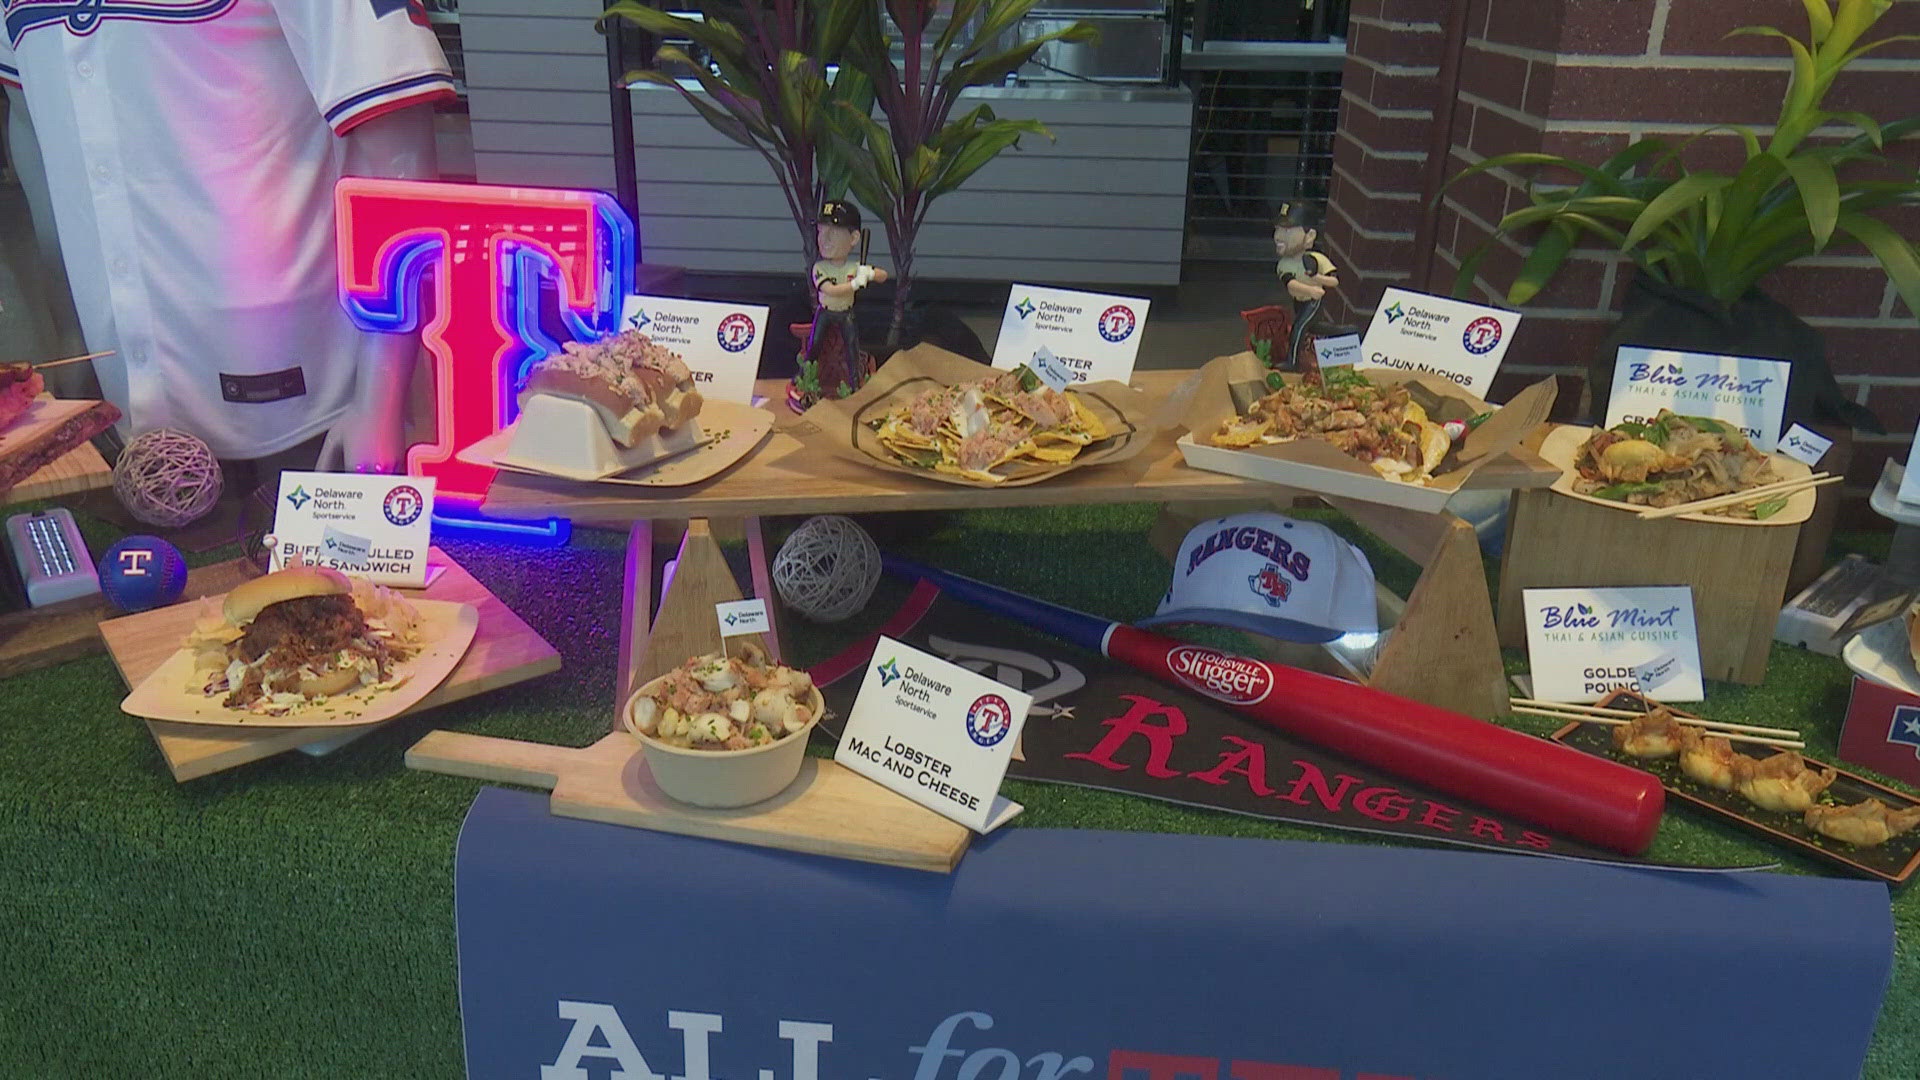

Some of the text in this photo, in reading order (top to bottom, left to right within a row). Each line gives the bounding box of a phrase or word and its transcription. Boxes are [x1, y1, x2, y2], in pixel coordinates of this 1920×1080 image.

[1040, 301, 1083, 314] Delaware
[1408, 306, 1450, 323] Delaware
[654, 312, 699, 324] Delaware
[1036, 312, 1064, 322] North
[1404, 317, 1430, 331] North
[652, 323, 681, 334] North
[1035, 322, 1073, 333] Sportservice
[1400, 328, 1437, 341] Sportservice
[334, 175, 636, 553] T
[1371, 352, 1414, 371] CAJUN
[1630, 362, 1774, 395] Blue Mint
[1628, 385, 1765, 407] THAI & ASIAN CUISINE
[314, 488, 363, 499] Delaware
[313, 500, 344, 509] North
[312, 511, 355, 520] Sportservice
[119, 549, 153, 577] T
[367, 548, 414, 560] ULLED
[1186, 526, 1312, 582] RANGERS
[330, 559, 411, 574] SANDWICH
[1540, 605, 1680, 629] Blue Mint
[1545, 630, 1679, 642] THAI & ASIAN CUISINE
[1176, 650, 1258, 695] Slugger
[1201, 652, 1260, 676] LOUISVILLE
[1584, 667, 1636, 679] GOLDE
[904, 666, 952, 697] Delaware
[899, 680, 930, 702] North
[894, 695, 937, 720] Sportservice
[885, 735, 952, 778] LOBSTER
[848, 737, 980, 811] MAC AND CHEESE
[1064, 694, 1553, 851] RANGERS
